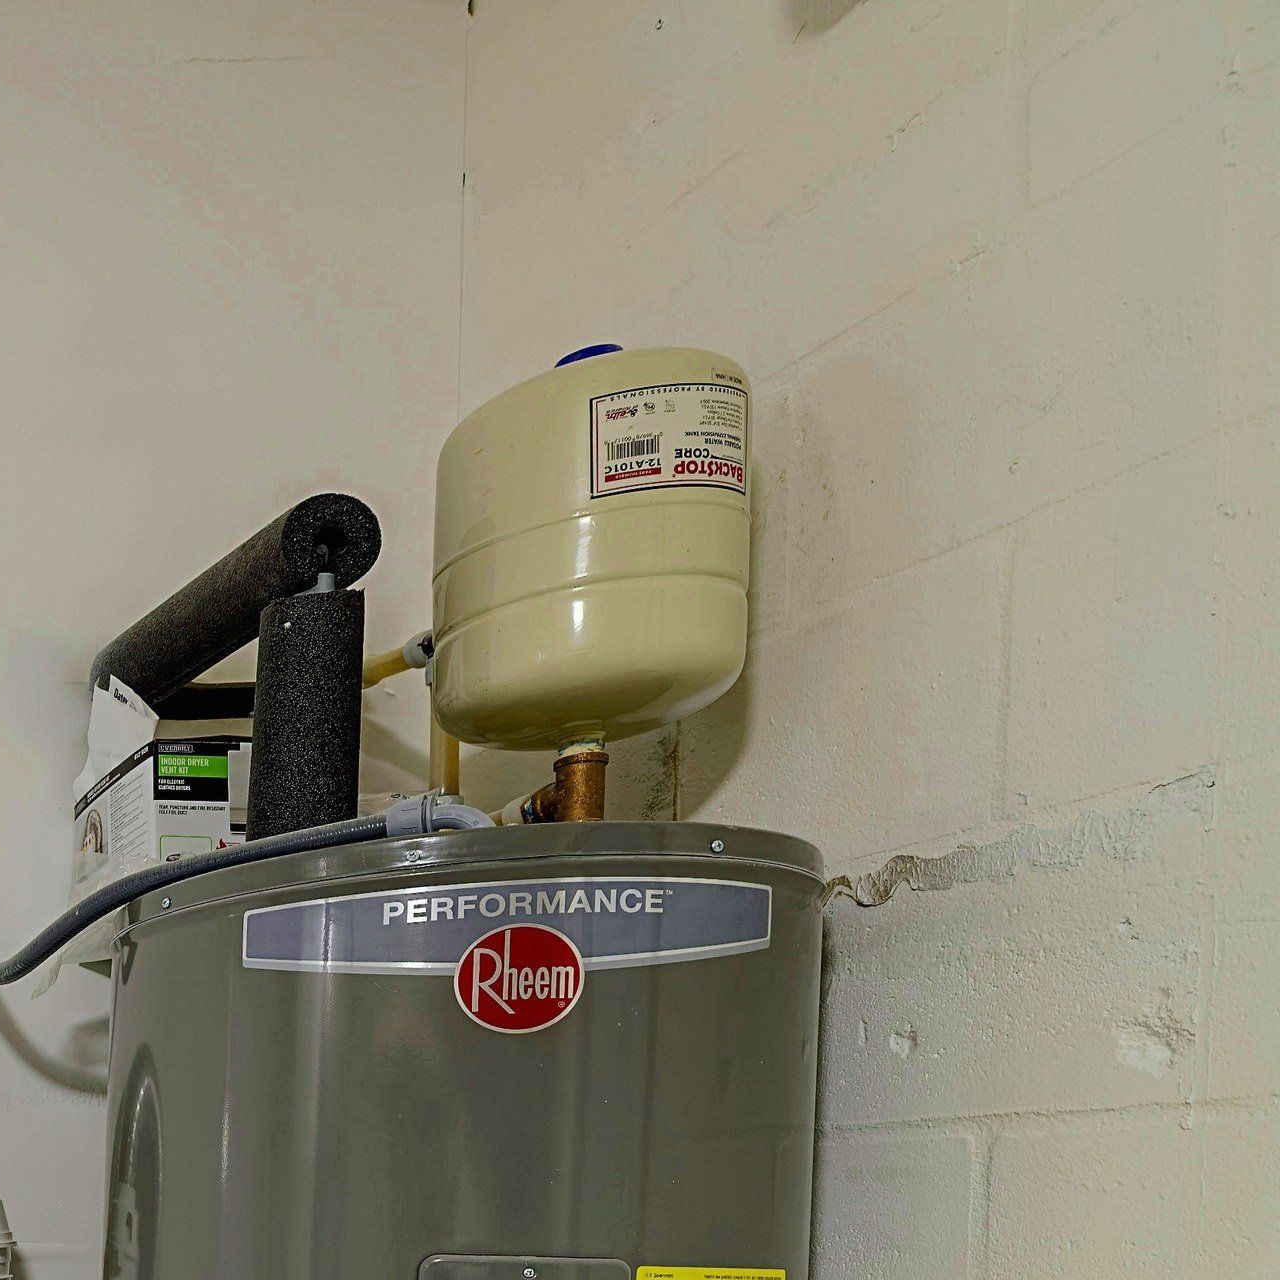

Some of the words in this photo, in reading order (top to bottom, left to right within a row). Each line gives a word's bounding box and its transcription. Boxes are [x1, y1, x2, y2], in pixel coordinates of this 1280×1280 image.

[610, 386, 691, 402] PROFESSIONALS
[704, 438, 723, 446] WATER
[675, 448, 709, 459] CORE
[605, 458, 662, 474] 12-A101C
[161, 758, 186, 766] INDOOR
[188, 758, 209, 766] DRYER
[161, 766, 177, 774] VENT
[179, 766, 189, 774] KIT
[382, 888, 665, 926] PERFORMANCE
[470, 928, 575, 1015] Rheem
